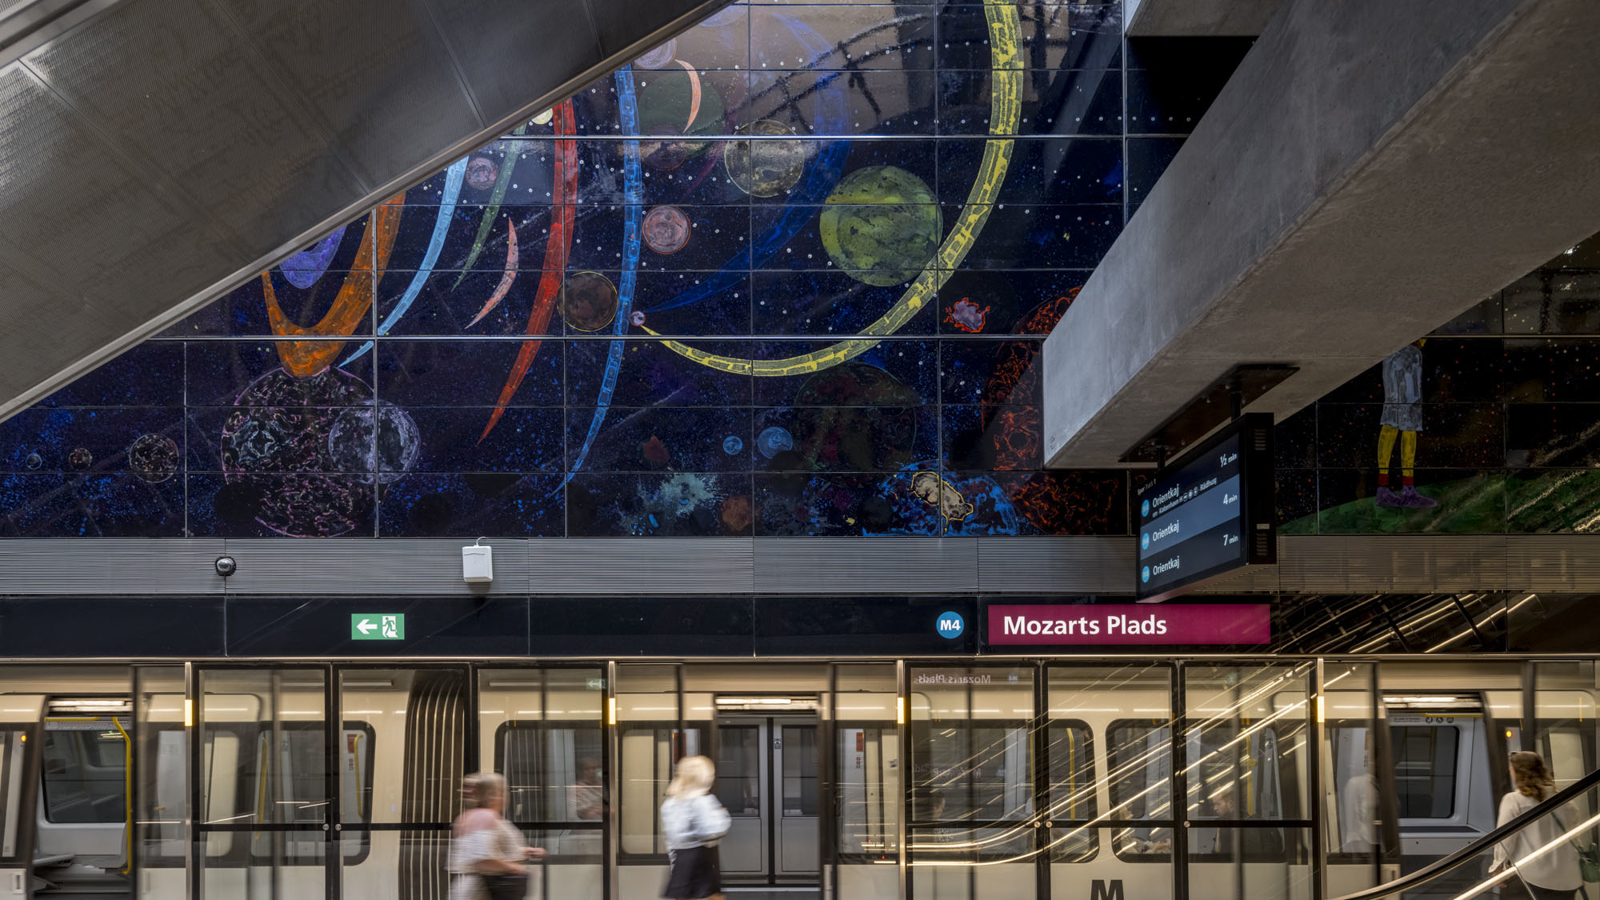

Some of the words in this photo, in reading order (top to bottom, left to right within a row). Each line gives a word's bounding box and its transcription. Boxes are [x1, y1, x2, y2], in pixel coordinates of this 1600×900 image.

[1228, 454, 1237, 463] min
[1153, 484, 1179, 507] Orientkaj
[1223, 494, 1228, 505] 4
[1229, 494, 1238, 504] min
[1153, 520, 1179, 541] Orientkaj
[1223, 535, 1229, 546] 7
[1229, 536, 1238, 544] min
[1153, 556, 1179, 576] Orientkaj
[939, 619, 961, 631] M4
[1003, 616, 1100, 635] Mozarts
[1107, 614, 1167, 635] Plads
